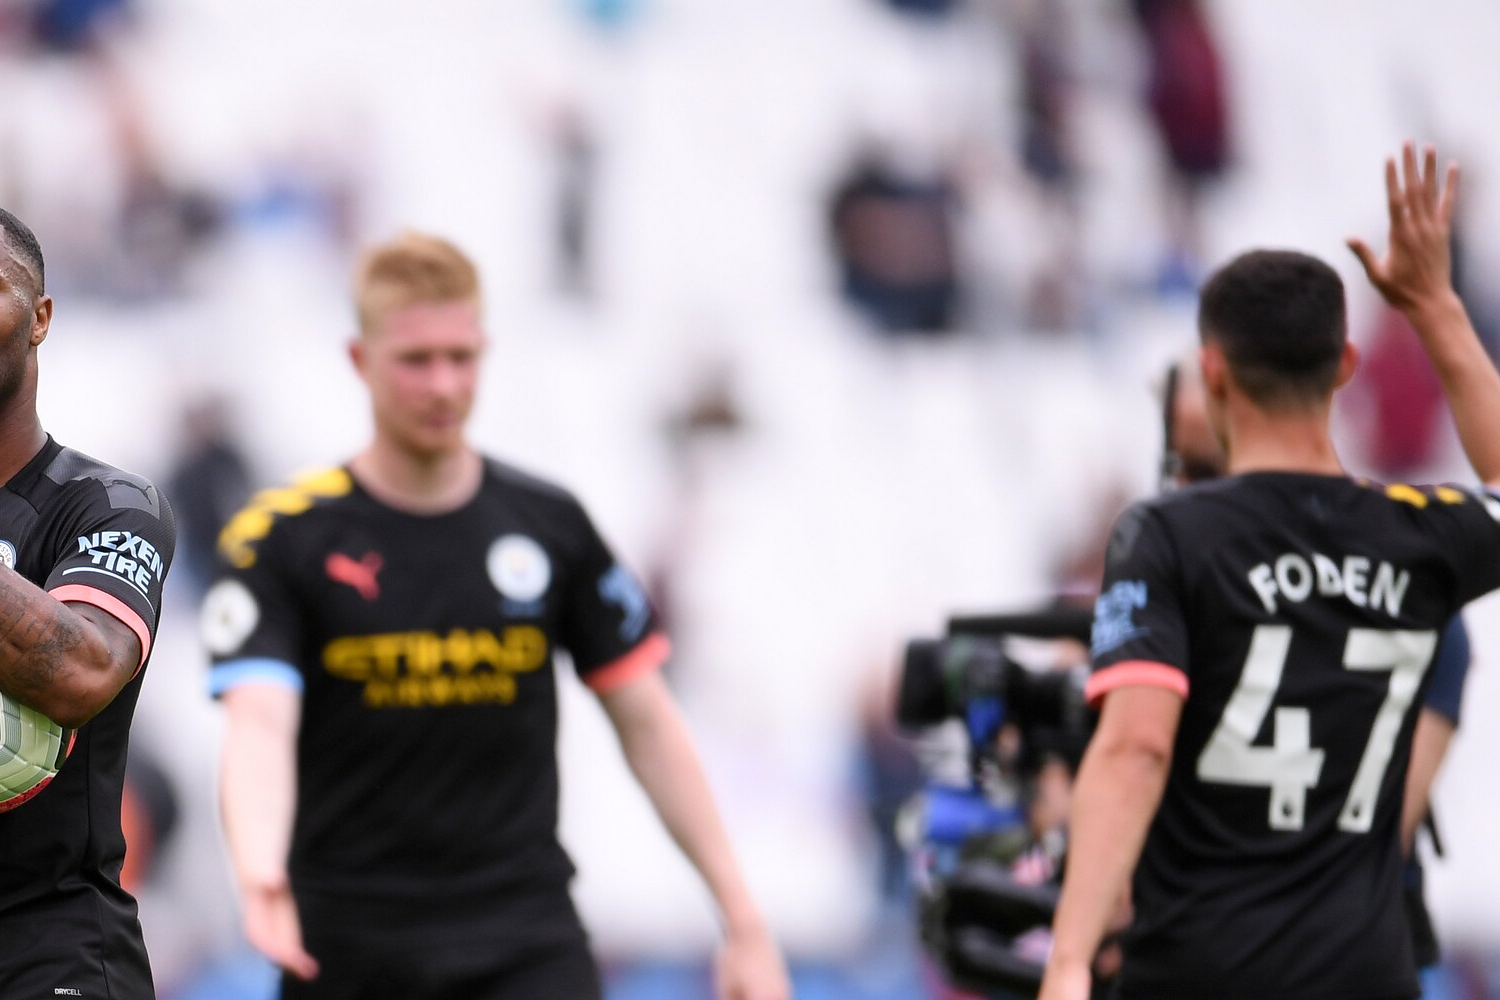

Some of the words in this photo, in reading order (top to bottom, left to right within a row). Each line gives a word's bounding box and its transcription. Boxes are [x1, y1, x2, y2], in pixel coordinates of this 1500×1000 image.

[77, 531, 164, 583] NEXEN
[88, 549, 152, 594] TIRE
[1248, 553, 1410, 617] FODEN
[323, 625, 548, 681] ETIHAD
[1197, 624, 1438, 834] 47
[54, 988, 82, 997] DRYCELL
